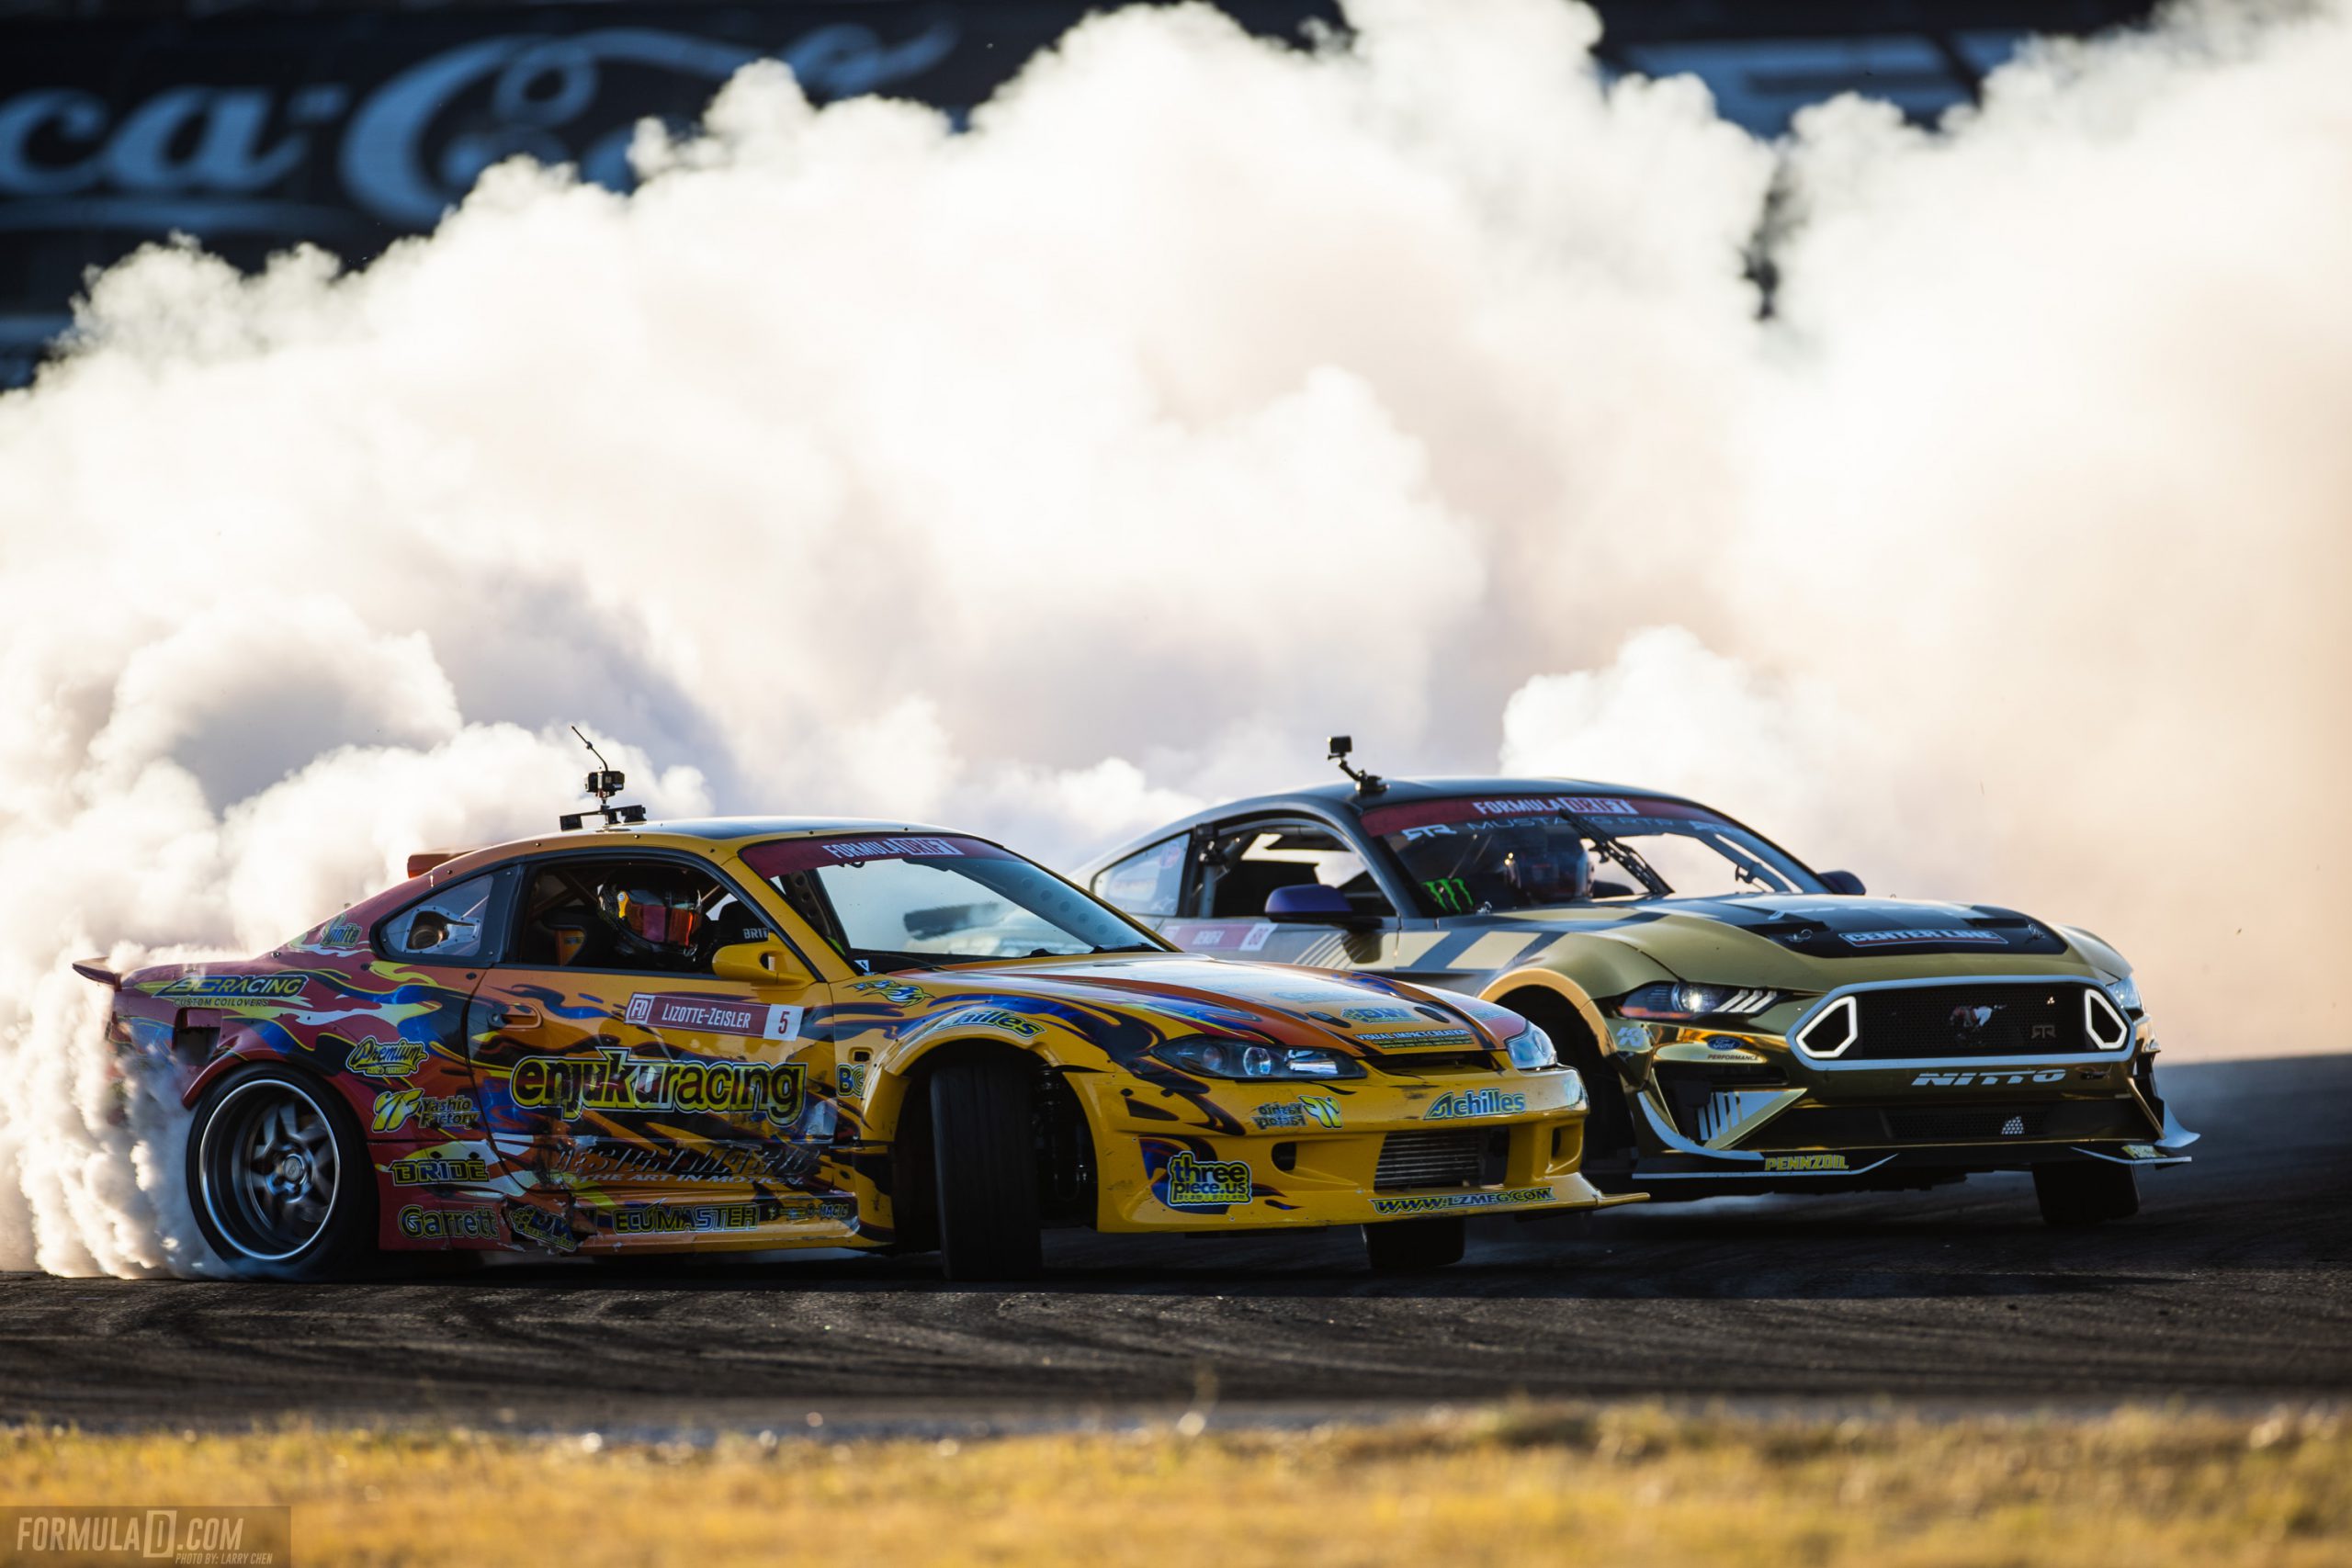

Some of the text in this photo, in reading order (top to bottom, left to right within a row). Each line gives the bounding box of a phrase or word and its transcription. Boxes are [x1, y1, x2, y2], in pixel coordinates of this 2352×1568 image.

[821, 840, 906, 858] FORMULA
[174, 998, 268, 1008] CUSTOM COILOVERS
[661, 1003, 752, 1029] LIZOTTE-ZEISLER
[777, 1010, 791, 1034] 5
[350, 1037, 428, 1066] Premium
[1713, 1037, 1736, 1050] Ford
[1707, 1054, 1758, 1062] PERFORMANCE
[514, 1049, 802, 1124] enjukuracing
[1911, 1069, 2066, 1086] NITTO
[423, 1096, 472, 1111] Yashio
[1424, 1089, 1526, 1119] Achilles
[420, 1111, 479, 1129] Factory
[392, 1160, 489, 1183] BRIDE
[1173, 1156, 1246, 1182] three
[1765, 1155, 1847, 1171] PENNZOIL
[629, 1173, 671, 1182] ART
[675, 1174, 705, 1182] IN
[1172, 1181, 1247, 1201] piece.us
[400, 1206, 500, 1238] Garrett
